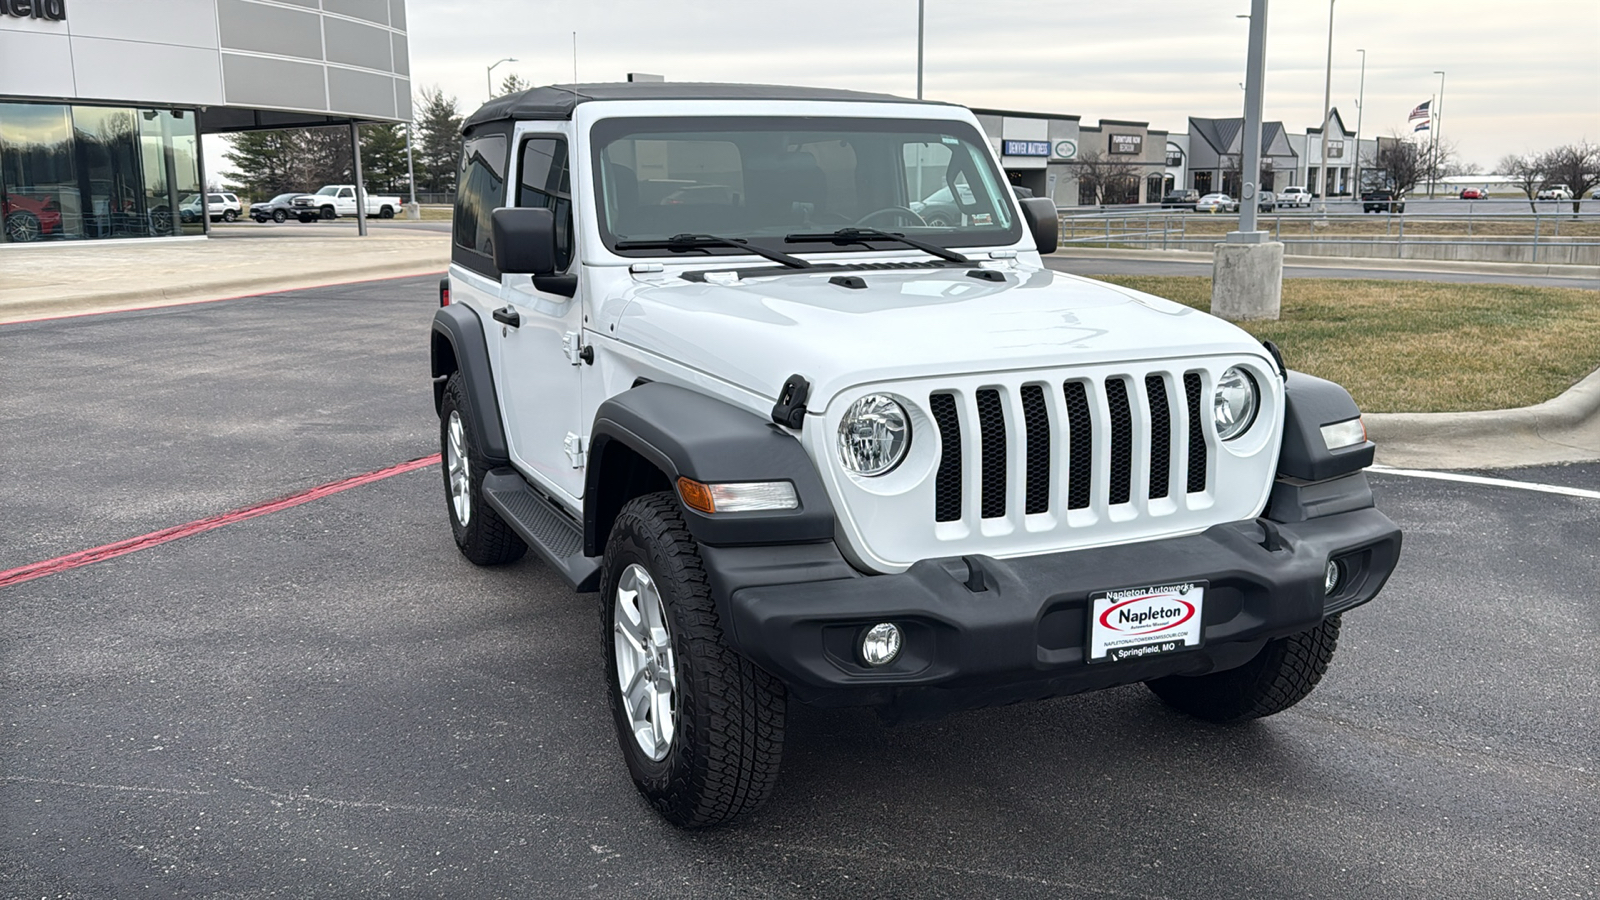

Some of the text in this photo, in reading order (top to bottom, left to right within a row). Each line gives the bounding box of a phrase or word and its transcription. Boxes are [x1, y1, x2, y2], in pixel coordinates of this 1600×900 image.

[1009, 141, 1027, 154] DENVER
[1028, 142, 1047, 154] MATTRESS
[1106, 583, 1195, 600] Napleton Autowerks
[1118, 606, 1181, 624] Napleton
[1118, 642, 1176, 658] Springfield, MO
